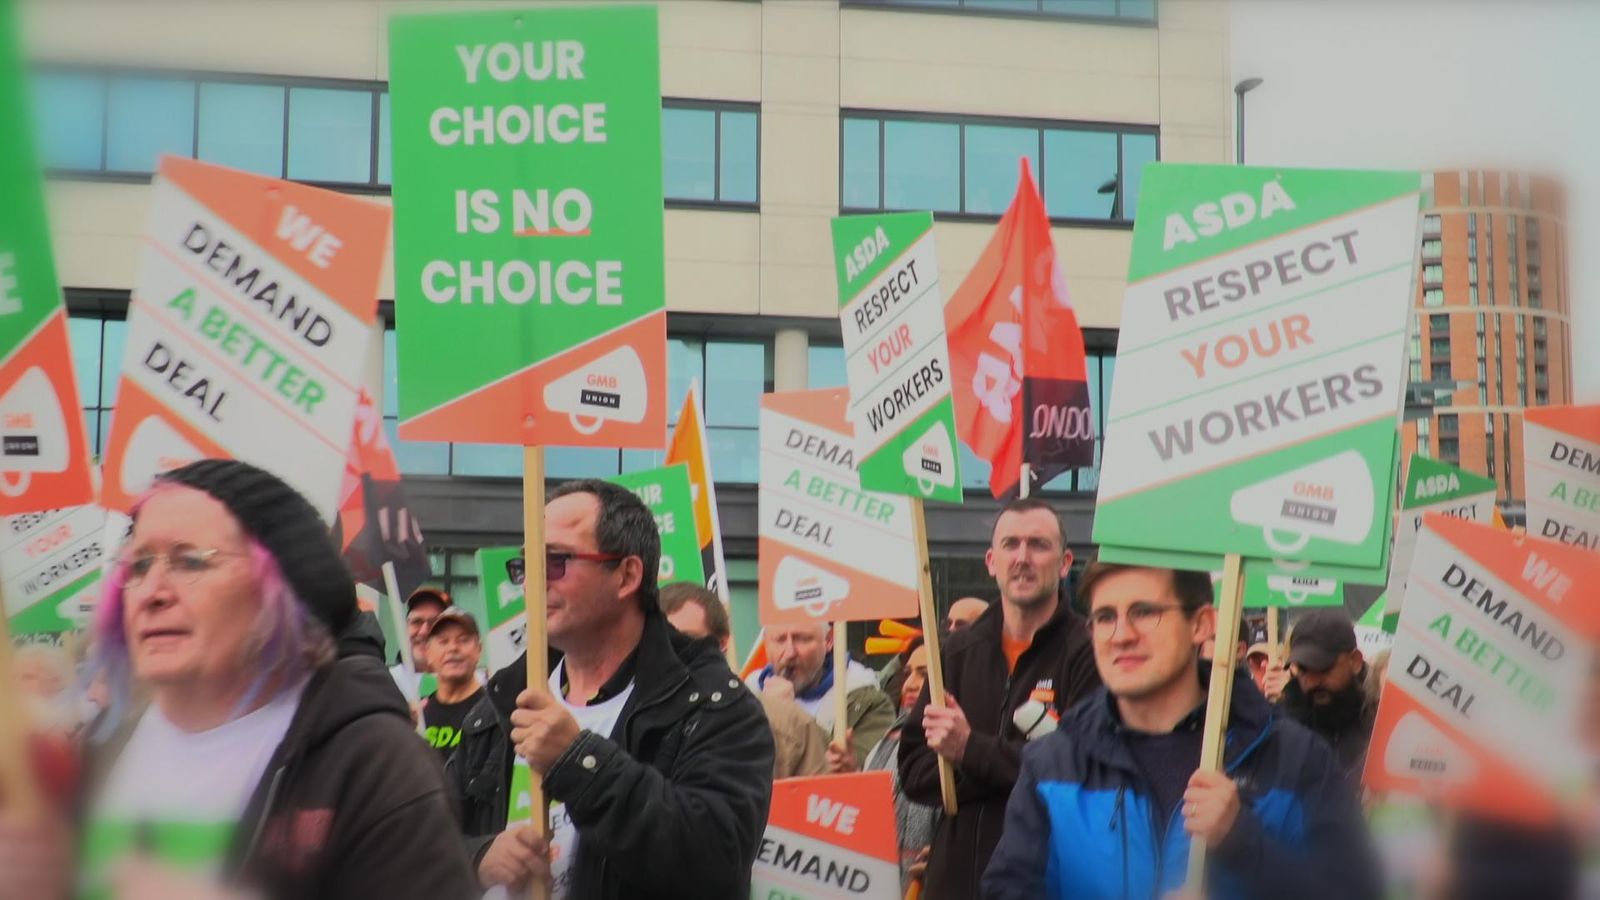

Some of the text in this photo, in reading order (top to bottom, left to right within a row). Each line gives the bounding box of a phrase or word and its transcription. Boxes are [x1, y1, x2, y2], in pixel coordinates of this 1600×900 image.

[455, 41, 585, 84] YOUR
[429, 103, 608, 146] CHOICE
[275, 205, 343, 269] WE
[455, 188, 593, 235] IS NO
[1162, 178, 1297, 252] ASDA
[843, 225, 891, 283] ASDA
[1163, 230, 1360, 322] RESPECT
[182, 224, 333, 347] DEMAND
[420, 259, 624, 306] CHOICE
[853, 258, 919, 334] RESPECT
[168, 288, 328, 415] A BETTER
[867, 323, 913, 375] YOUR
[1180, 313, 1315, 380] YOUR
[144, 342, 227, 423] DEAL
[584, 392, 617, 406] UNION
[586, 374, 618, 389] GMB
[866, 358, 944, 433] WORKERS
[1147, 363, 1384, 462] WORKERS
[784, 428, 860, 472] DEMA
[784, 468, 896, 523] A BETTER
[1292, 481, 1334, 502] GMB
[1414, 471, 1460, 500] ASDA
[1550, 480, 1568, 501] A
[774, 508, 835, 549] DEAL
[22, 541, 103, 596] WORKERS
[1521, 551, 1574, 605] WE
[1441, 562, 1566, 663] DEMAND
[1405, 653, 1478, 721] DEAL
[1427, 612, 1558, 714] A BETTER
[805, 793, 862, 837] WE
[757, 838, 870, 893] EMAND
